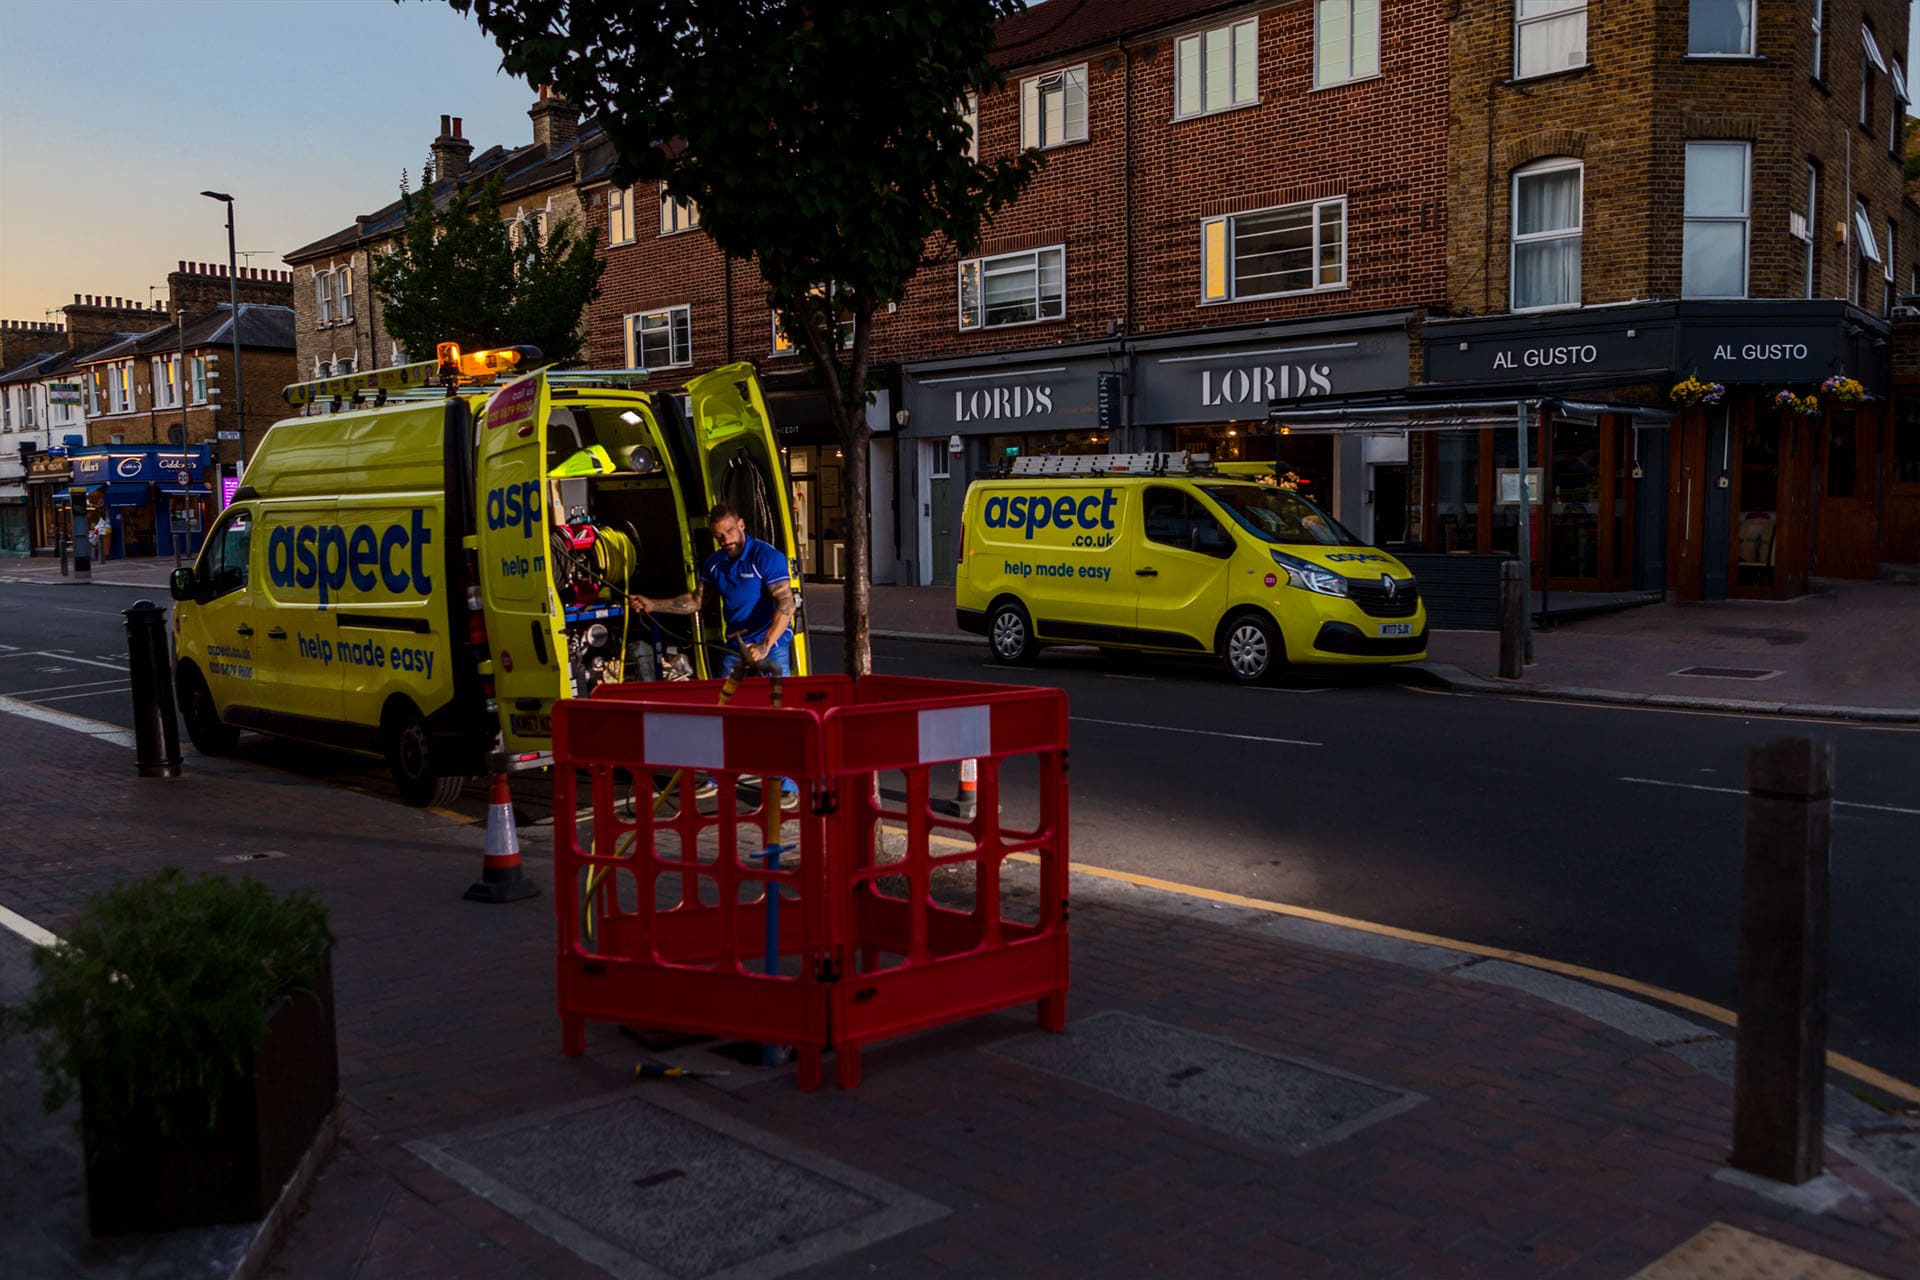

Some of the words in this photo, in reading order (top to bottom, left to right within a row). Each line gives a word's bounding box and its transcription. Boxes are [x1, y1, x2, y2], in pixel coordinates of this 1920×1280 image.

[1493, 351, 1519, 369] AL
[1523, 345, 1597, 368] GUSTO
[1713, 344, 1736, 361] AL
[1740, 343, 1808, 360] GUSTO
[956, 385, 1053, 422] LORDS
[1099, 376, 1110, 430] LORDS
[1202, 363, 1334, 407] LORDS
[985, 489, 1117, 539] aspect
[1071, 532, 1114, 548] .co.uk
[268, 509, 432, 610] aspect
[502, 555, 529, 578] help
[1004, 560, 1033, 579] help
[1036, 561, 1075, 578] made
[1079, 564, 1112, 582] easy
[298, 632, 333, 666] help
[337, 639, 385, 668] made
[390, 646, 434, 680] easy
